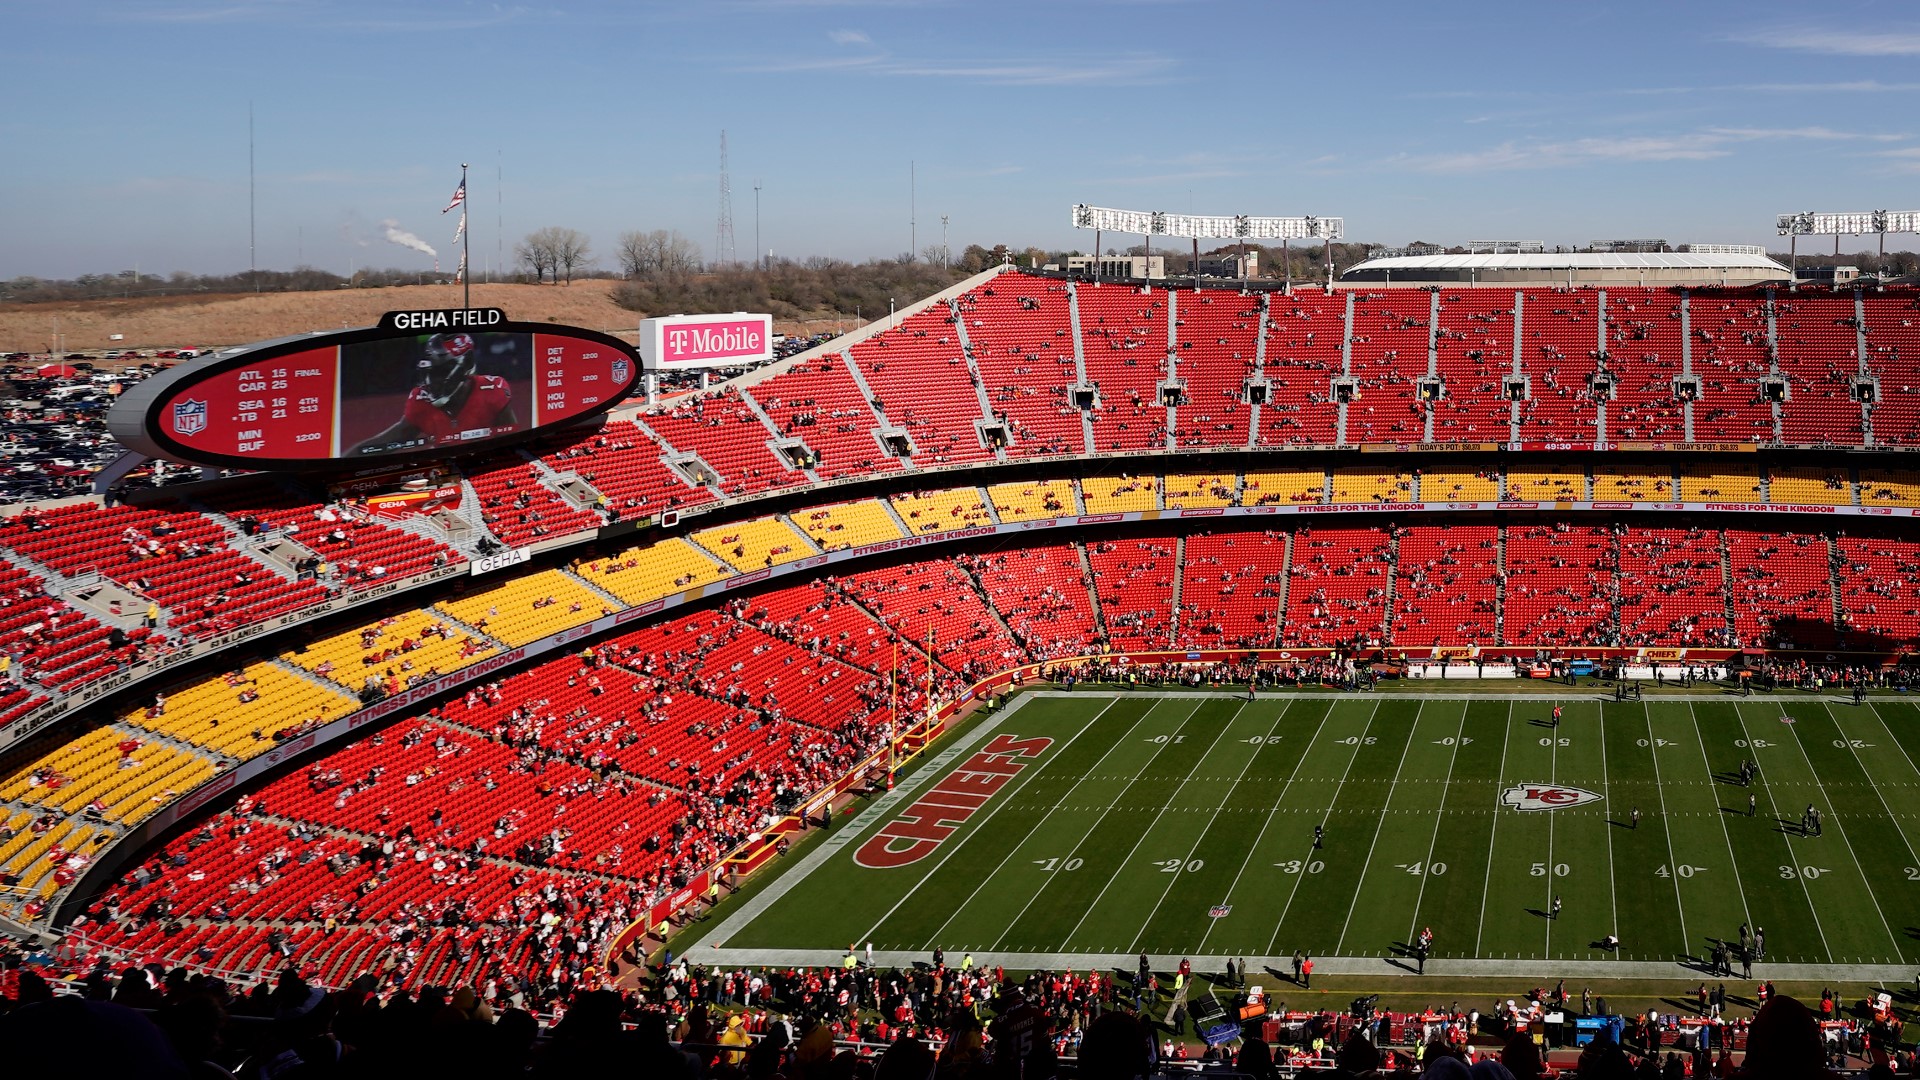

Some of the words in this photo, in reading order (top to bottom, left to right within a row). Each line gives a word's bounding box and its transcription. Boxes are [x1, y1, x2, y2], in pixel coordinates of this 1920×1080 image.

[395, 312, 448, 329] GEHA
[453, 310, 500, 326] FIELD
[670, 331, 687, 354] T
[692, 327, 759, 353] Mobile
[548, 347, 564, 355] DET
[238, 370, 264, 380] ATL
[272, 369, 286, 378] 15
[295, 369, 321, 377] FINAL
[548, 370, 563, 378] CLE
[239, 382, 266, 392] CAR
[272, 381, 287, 389] 25
[548, 379, 562, 387] MIA
[547, 393, 564, 401] HOU
[238, 400, 264, 410] SEA
[272, 398, 286, 406] 16
[240, 412, 257, 421] TB
[272, 410, 286, 418] 21
[178, 414, 202, 429] NFL
[238, 430, 261, 440] MIN
[296, 433, 321, 442] 12:00
[239, 441, 264, 452] BUF
[351, 481, 379, 490] GEHA
[838, 476, 869, 484] STENERUD
[435, 488, 455, 498] GEHA
[793, 484, 815, 492] HAYNES
[748, 493, 767, 501] LYNCH
[379, 500, 406, 508] GEHA
[697, 501, 724, 511] PODOLAK
[853, 542, 898, 556] FITNESS
[900, 538, 921, 547] FOR
[924, 532, 945, 543] THE
[947, 526, 996, 539] KINGDOM
[480, 551, 522, 571] GEHA
[429, 567, 456, 580] WILSON
[347, 593, 369, 604] HANK
[371, 584, 396, 597] STRAM
[298, 603, 332, 619] THOMAS
[231, 625, 263, 641] LANIER
[1440, 649, 1471, 658] CHIEFS
[1646, 650, 1677, 658] CHIEFS
[155, 662, 162, 670] E.
[164, 649, 193, 666] BUDDE
[101, 673, 131, 692] TAYLOR
[349, 695, 407, 728] FITNESS
[410, 684, 437, 701] FOR
[439, 672, 466, 691] THE
[467, 649, 525, 681] KINGDOM
[1154, 735, 1188, 744] 10
[1249, 735, 1283, 744] 20
[1346, 736, 1378, 745] 30
[1442, 737, 1474, 746] 40
[1539, 738, 1570, 746] 50
[1636, 738, 1668, 747] 40
[1734, 739, 1767, 748] 30
[1833, 739, 1865, 748] 20
[827, 835, 849, 845] IT
[846, 796, 899, 830] TAKES
[900, 775, 927, 793] ALL
[922, 761, 943, 772] OF
[944, 747, 962, 758] US
[852, 734, 1055, 869] CHIEFS
[1525, 789, 1579, 804] KC
[1040, 858, 1083, 871] 10
[1160, 859, 1204, 872] 20
[1284, 860, 1325, 874] 30
[1406, 862, 1447, 875] 40
[1530, 863, 1570, 876] 50
[1655, 864, 1694, 878] 40
[1779, 866, 1820, 879] 30
